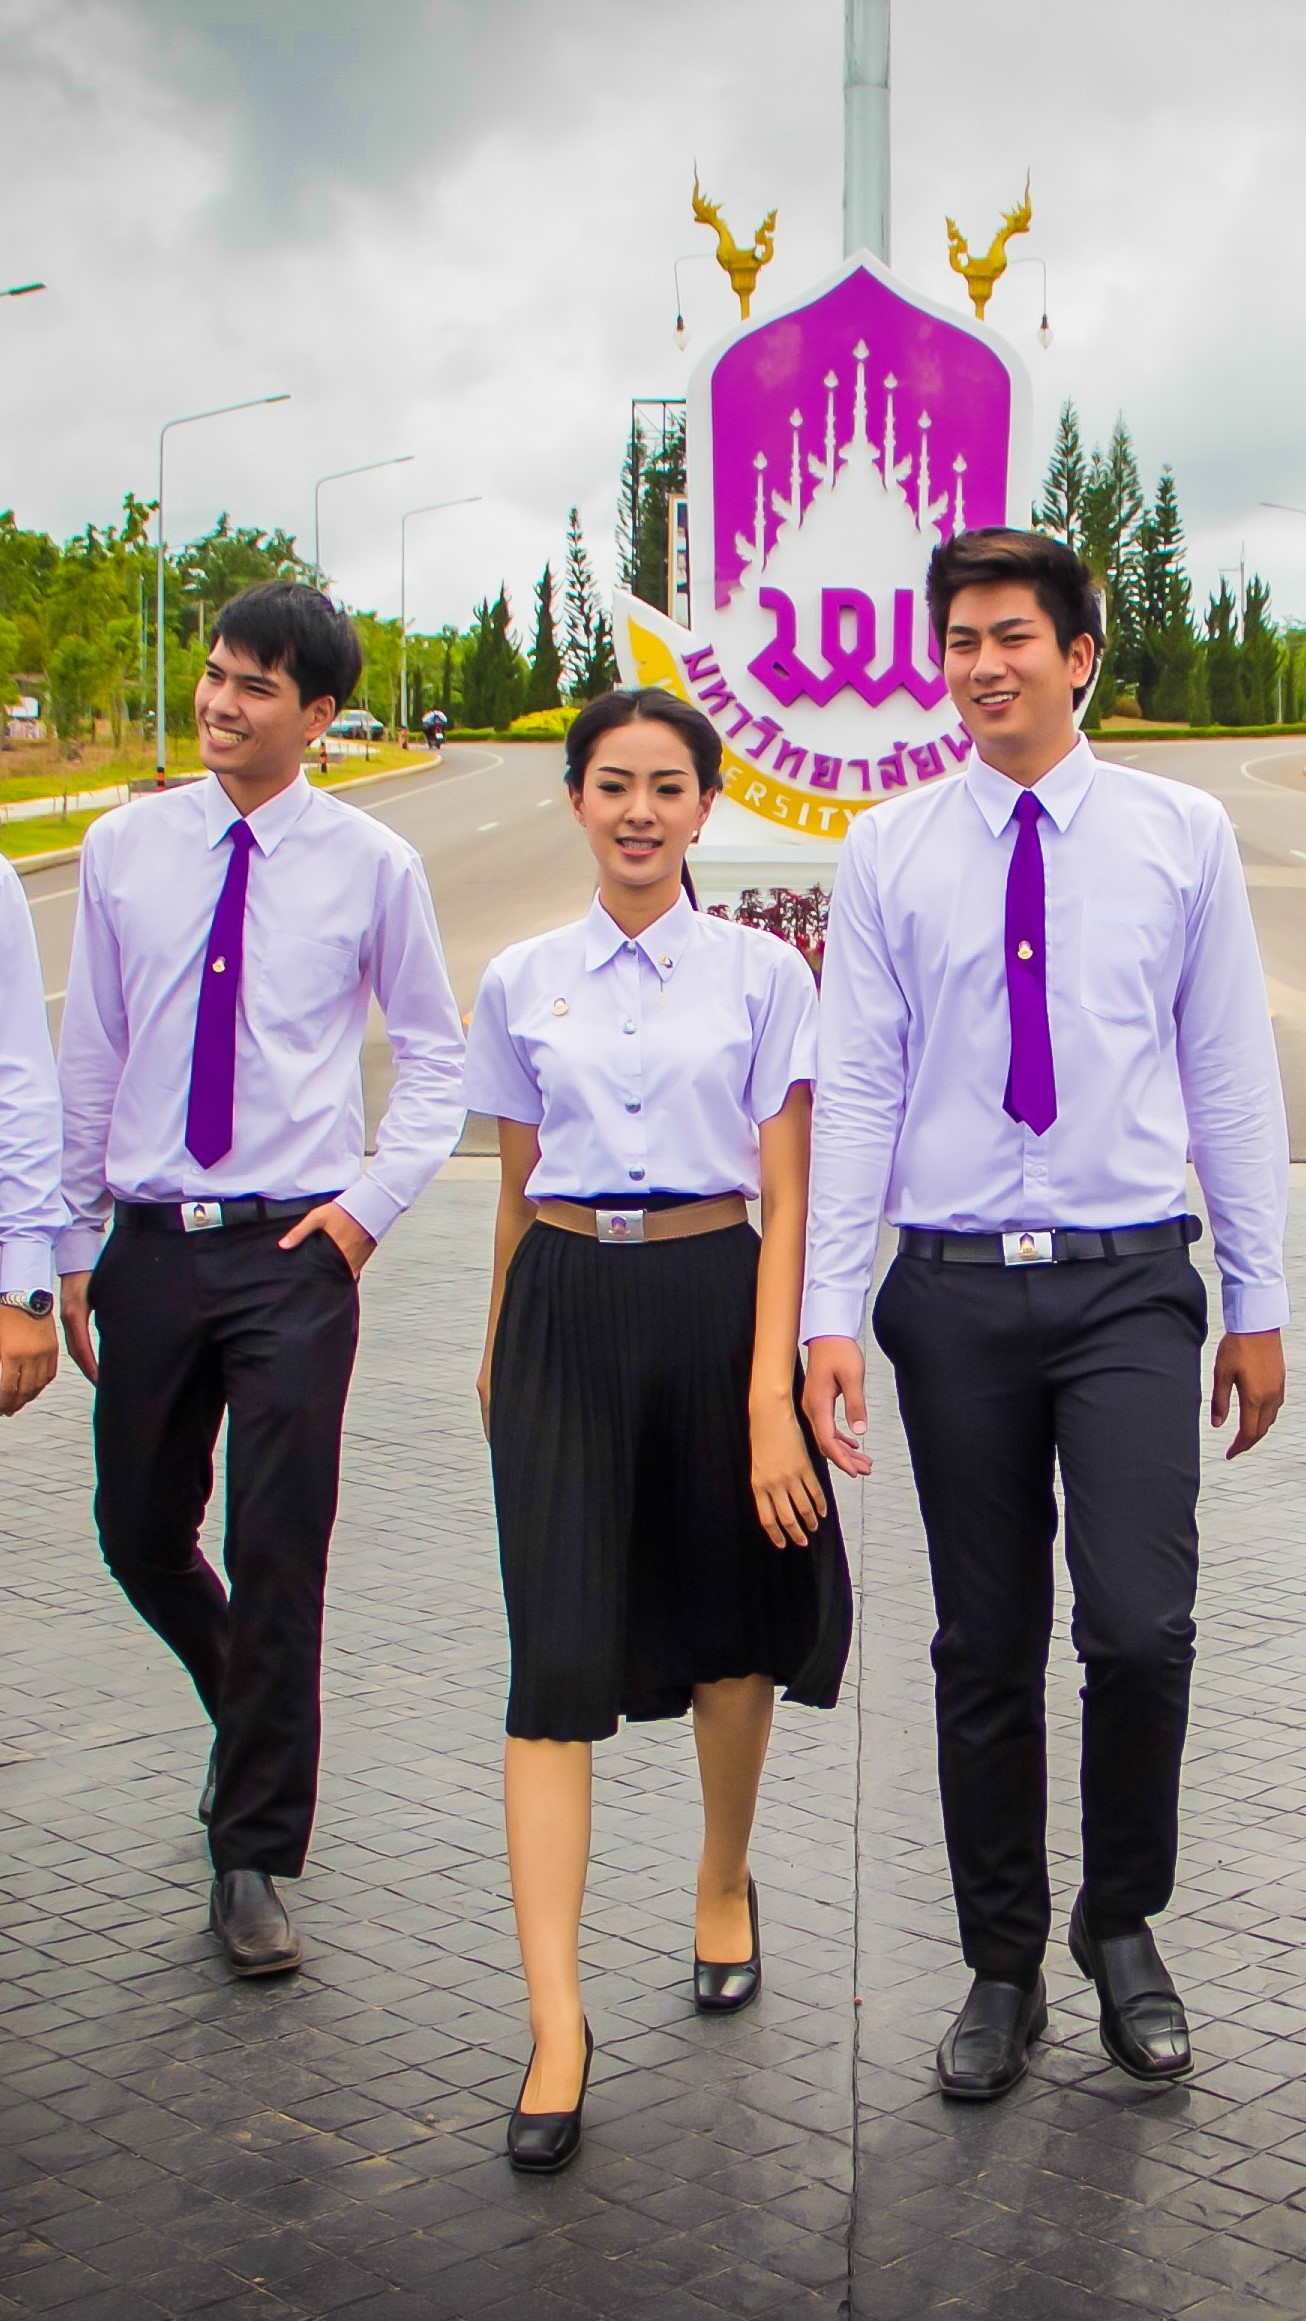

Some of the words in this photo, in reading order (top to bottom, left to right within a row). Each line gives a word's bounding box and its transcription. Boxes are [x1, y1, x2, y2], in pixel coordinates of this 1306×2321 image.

[681, 643, 974, 791] มหาวิทยาลัยพ
[722, 764, 863, 831] ERSITY
